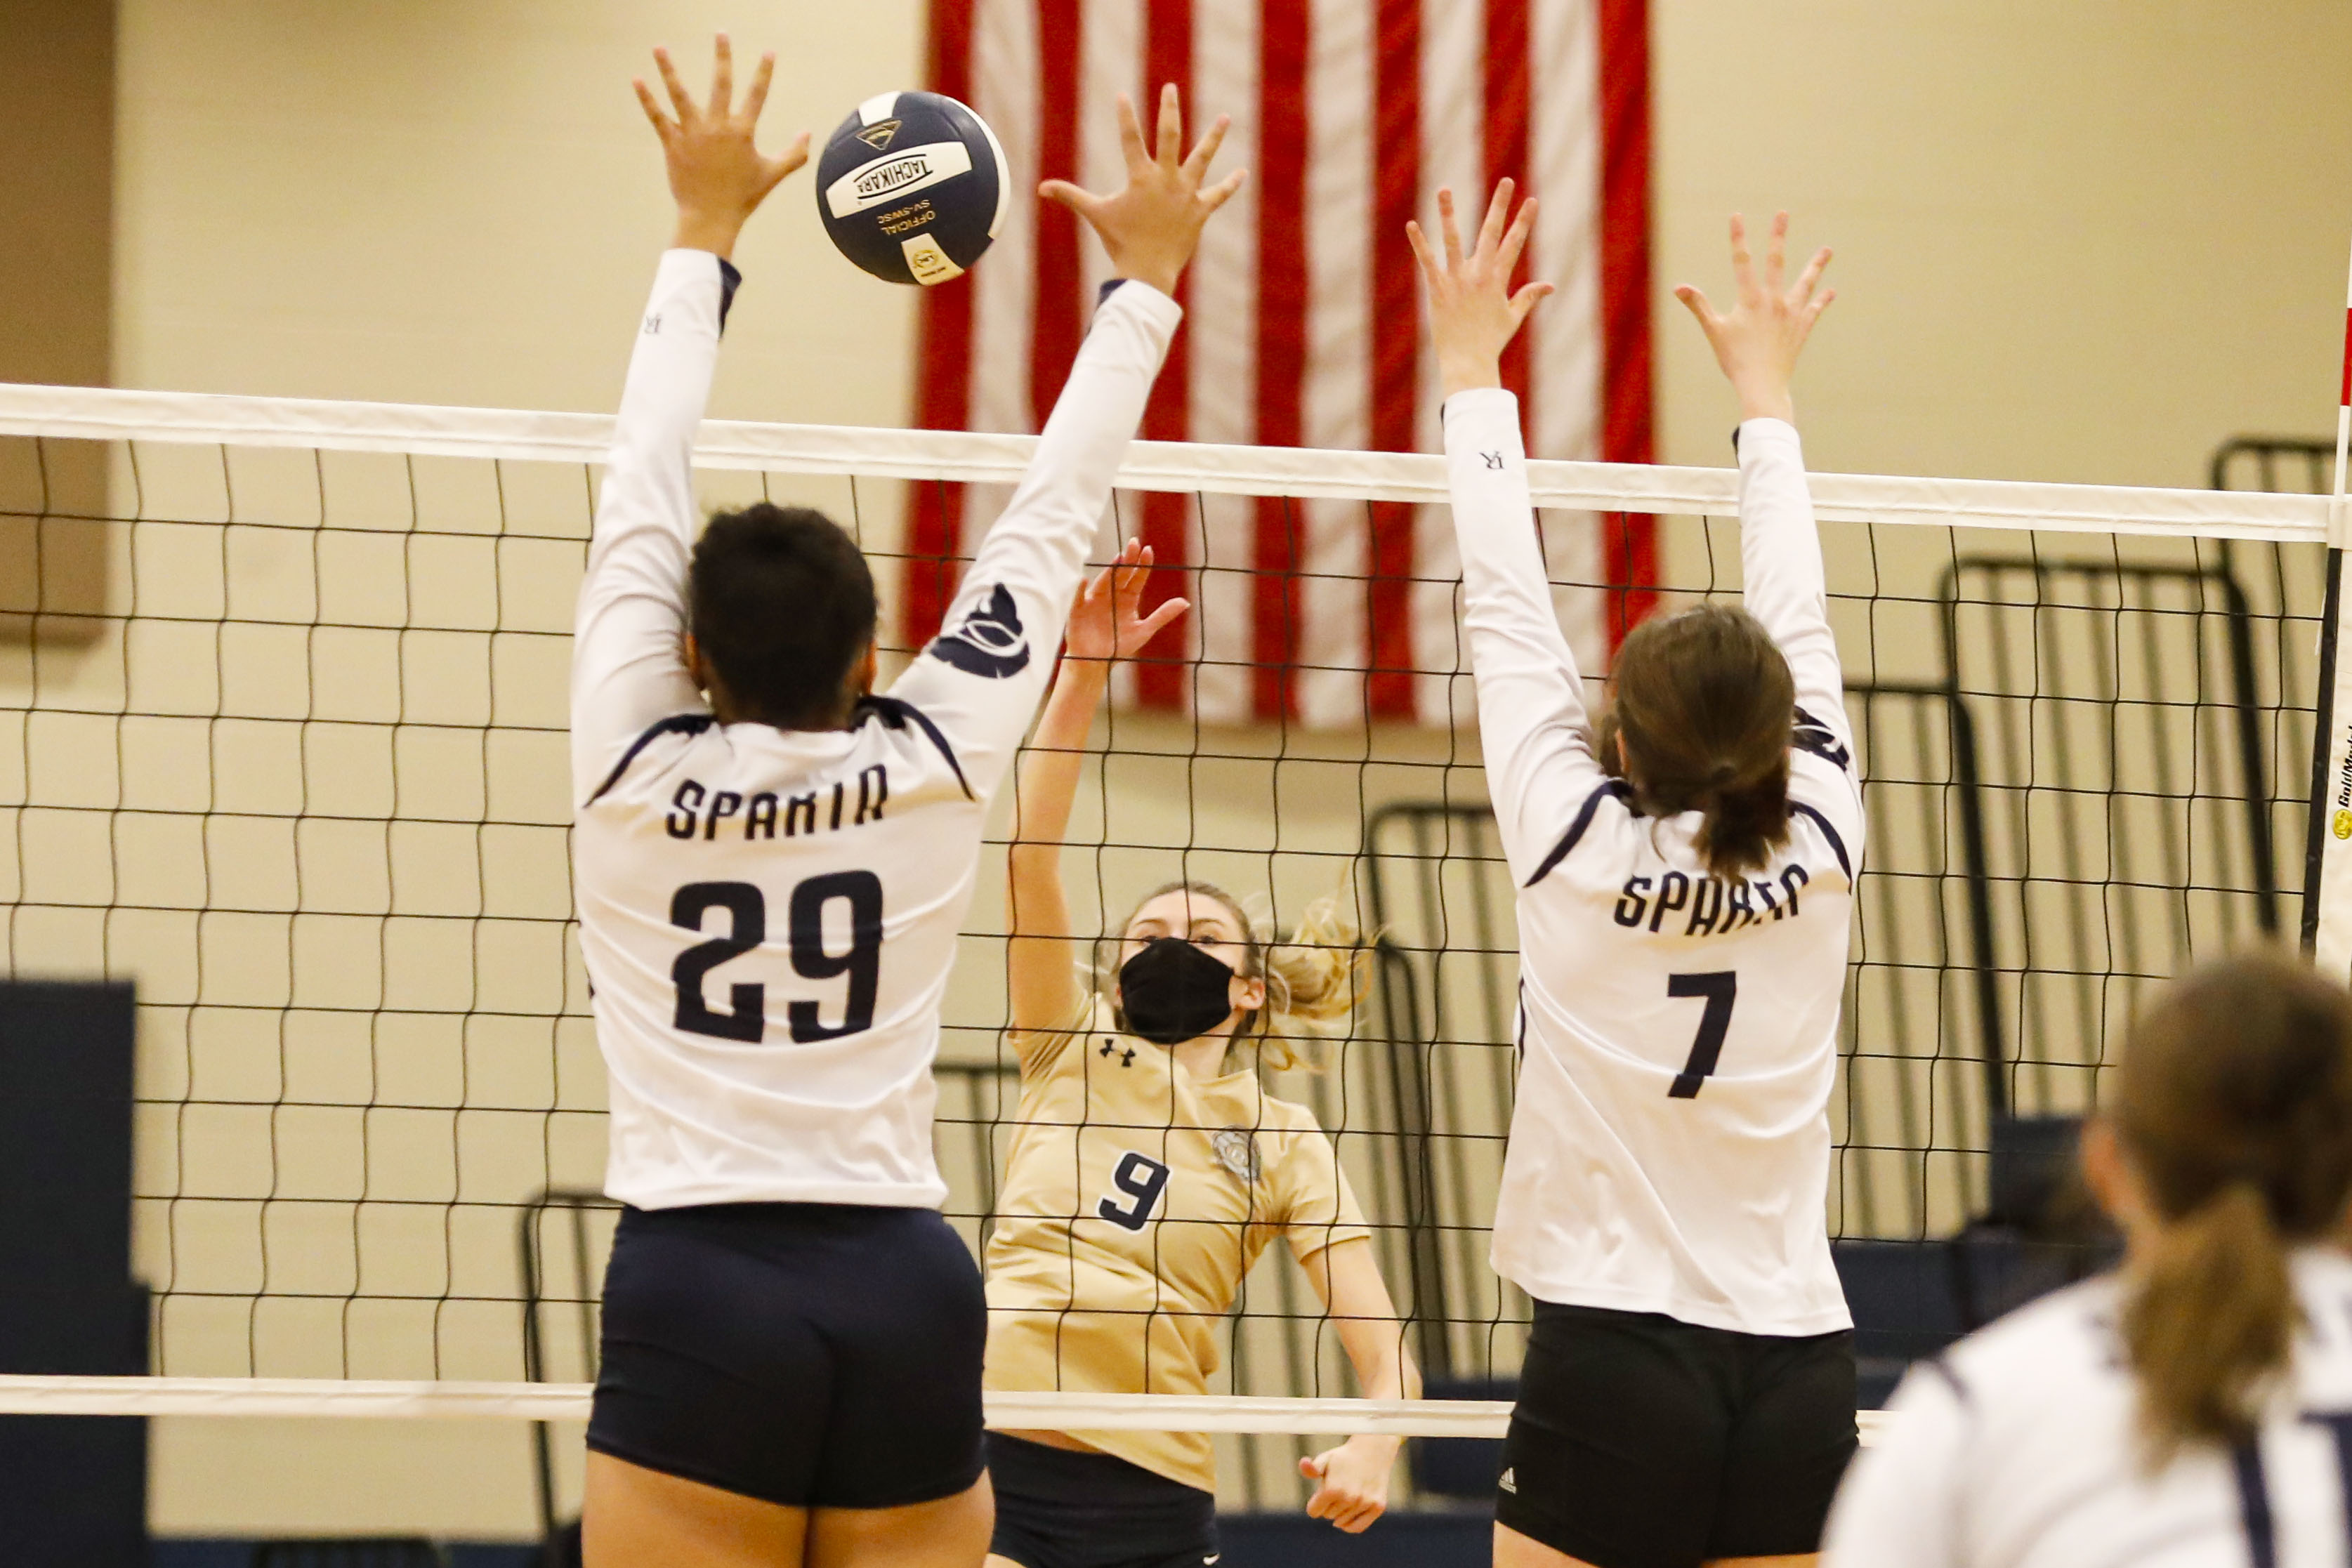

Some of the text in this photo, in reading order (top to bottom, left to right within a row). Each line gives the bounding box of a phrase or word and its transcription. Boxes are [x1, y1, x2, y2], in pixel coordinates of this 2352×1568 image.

[857, 159, 933, 194] TACHIKARA
[880, 210, 936, 236] OFFICIAL
[669, 869, 883, 1045] 29
[1667, 970, 1737, 1100] 7
[1096, 1150, 1174, 1234] 9
